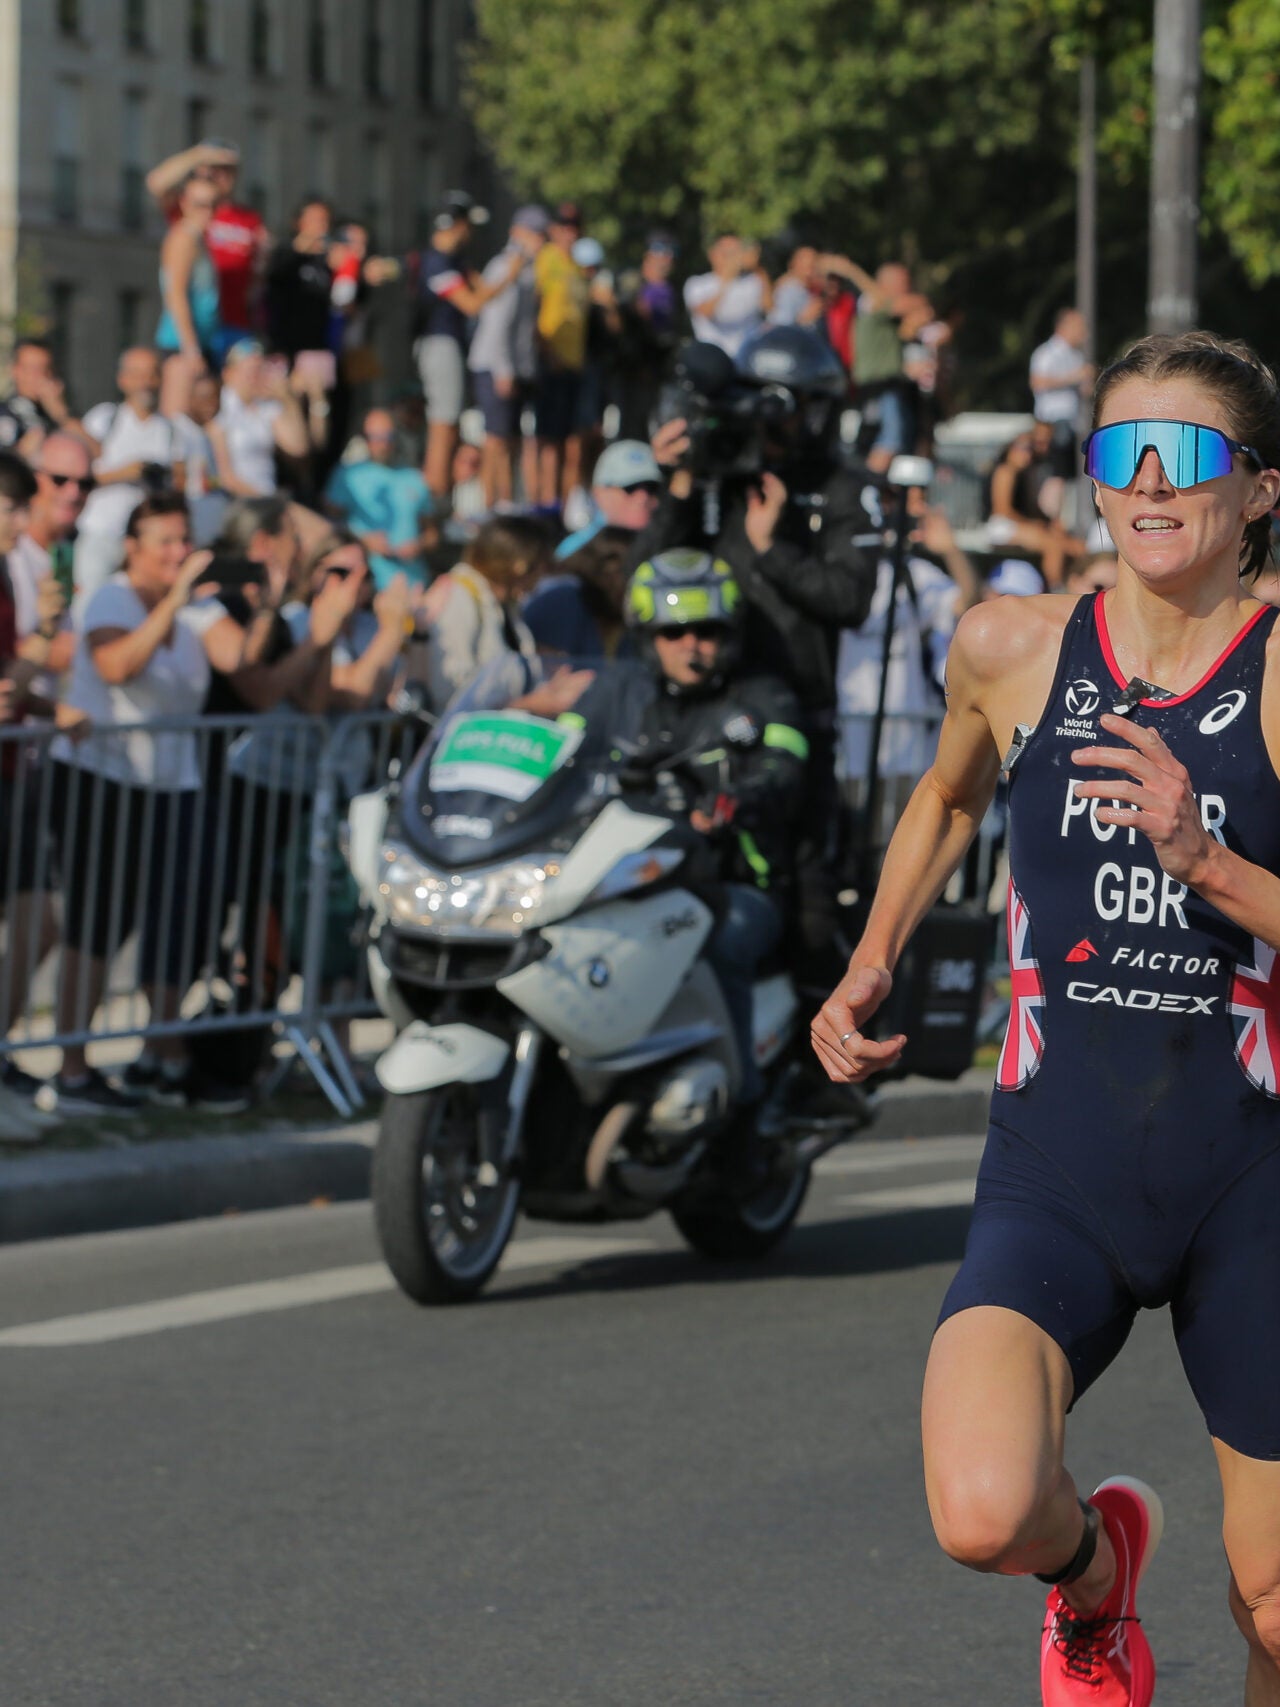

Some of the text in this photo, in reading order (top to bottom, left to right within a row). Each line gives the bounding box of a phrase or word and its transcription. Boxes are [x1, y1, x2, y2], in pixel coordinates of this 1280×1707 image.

[1055, 726, 1097, 740] Triathlon
[1064, 717, 1093, 729] World
[1060, 778, 1228, 848] POR
[1094, 861, 1190, 929] GBR
[1111, 946, 1220, 975] FACTOR
[1066, 981, 1220, 1015] CADEX
